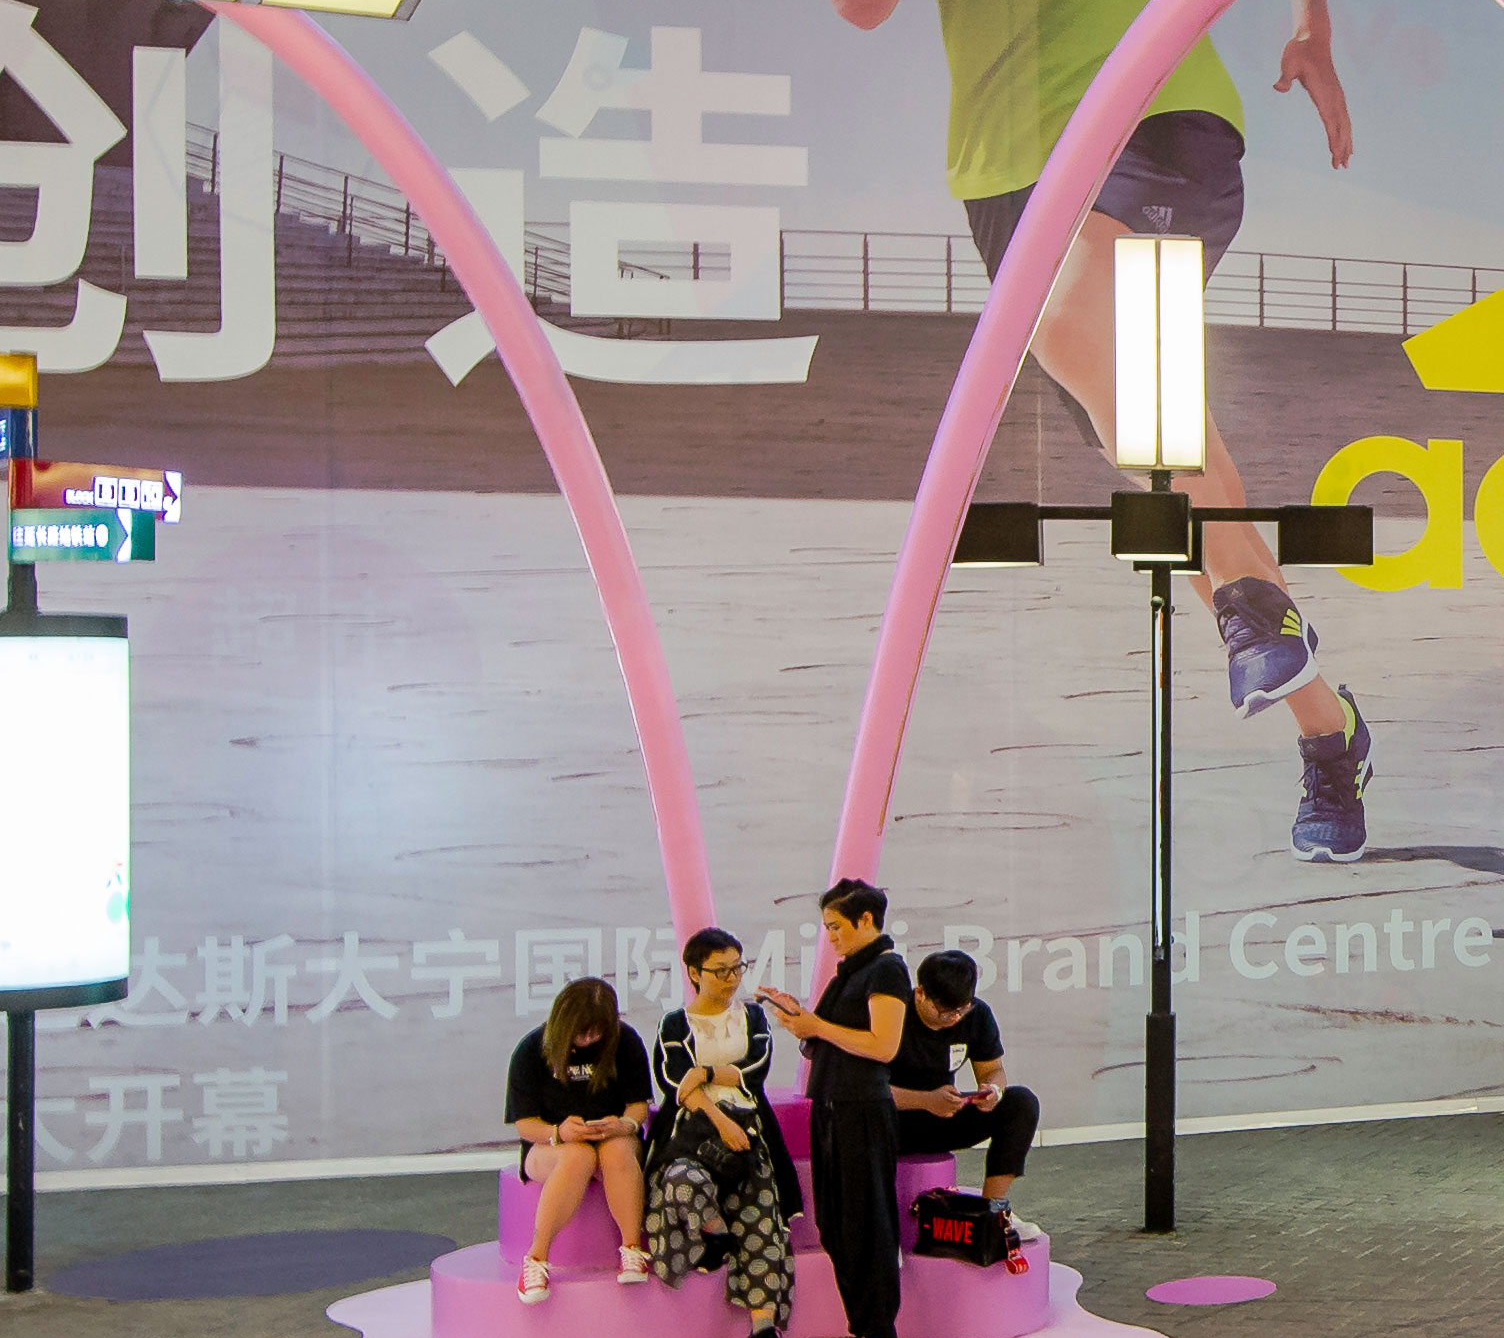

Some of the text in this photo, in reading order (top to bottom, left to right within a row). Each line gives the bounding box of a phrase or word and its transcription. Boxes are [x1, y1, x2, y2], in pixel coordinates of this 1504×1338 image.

[943, 910, 1201, 995] Brand
[1229, 908, 1494, 980] Centre
[932, 1216, 974, 1245] WAVE
